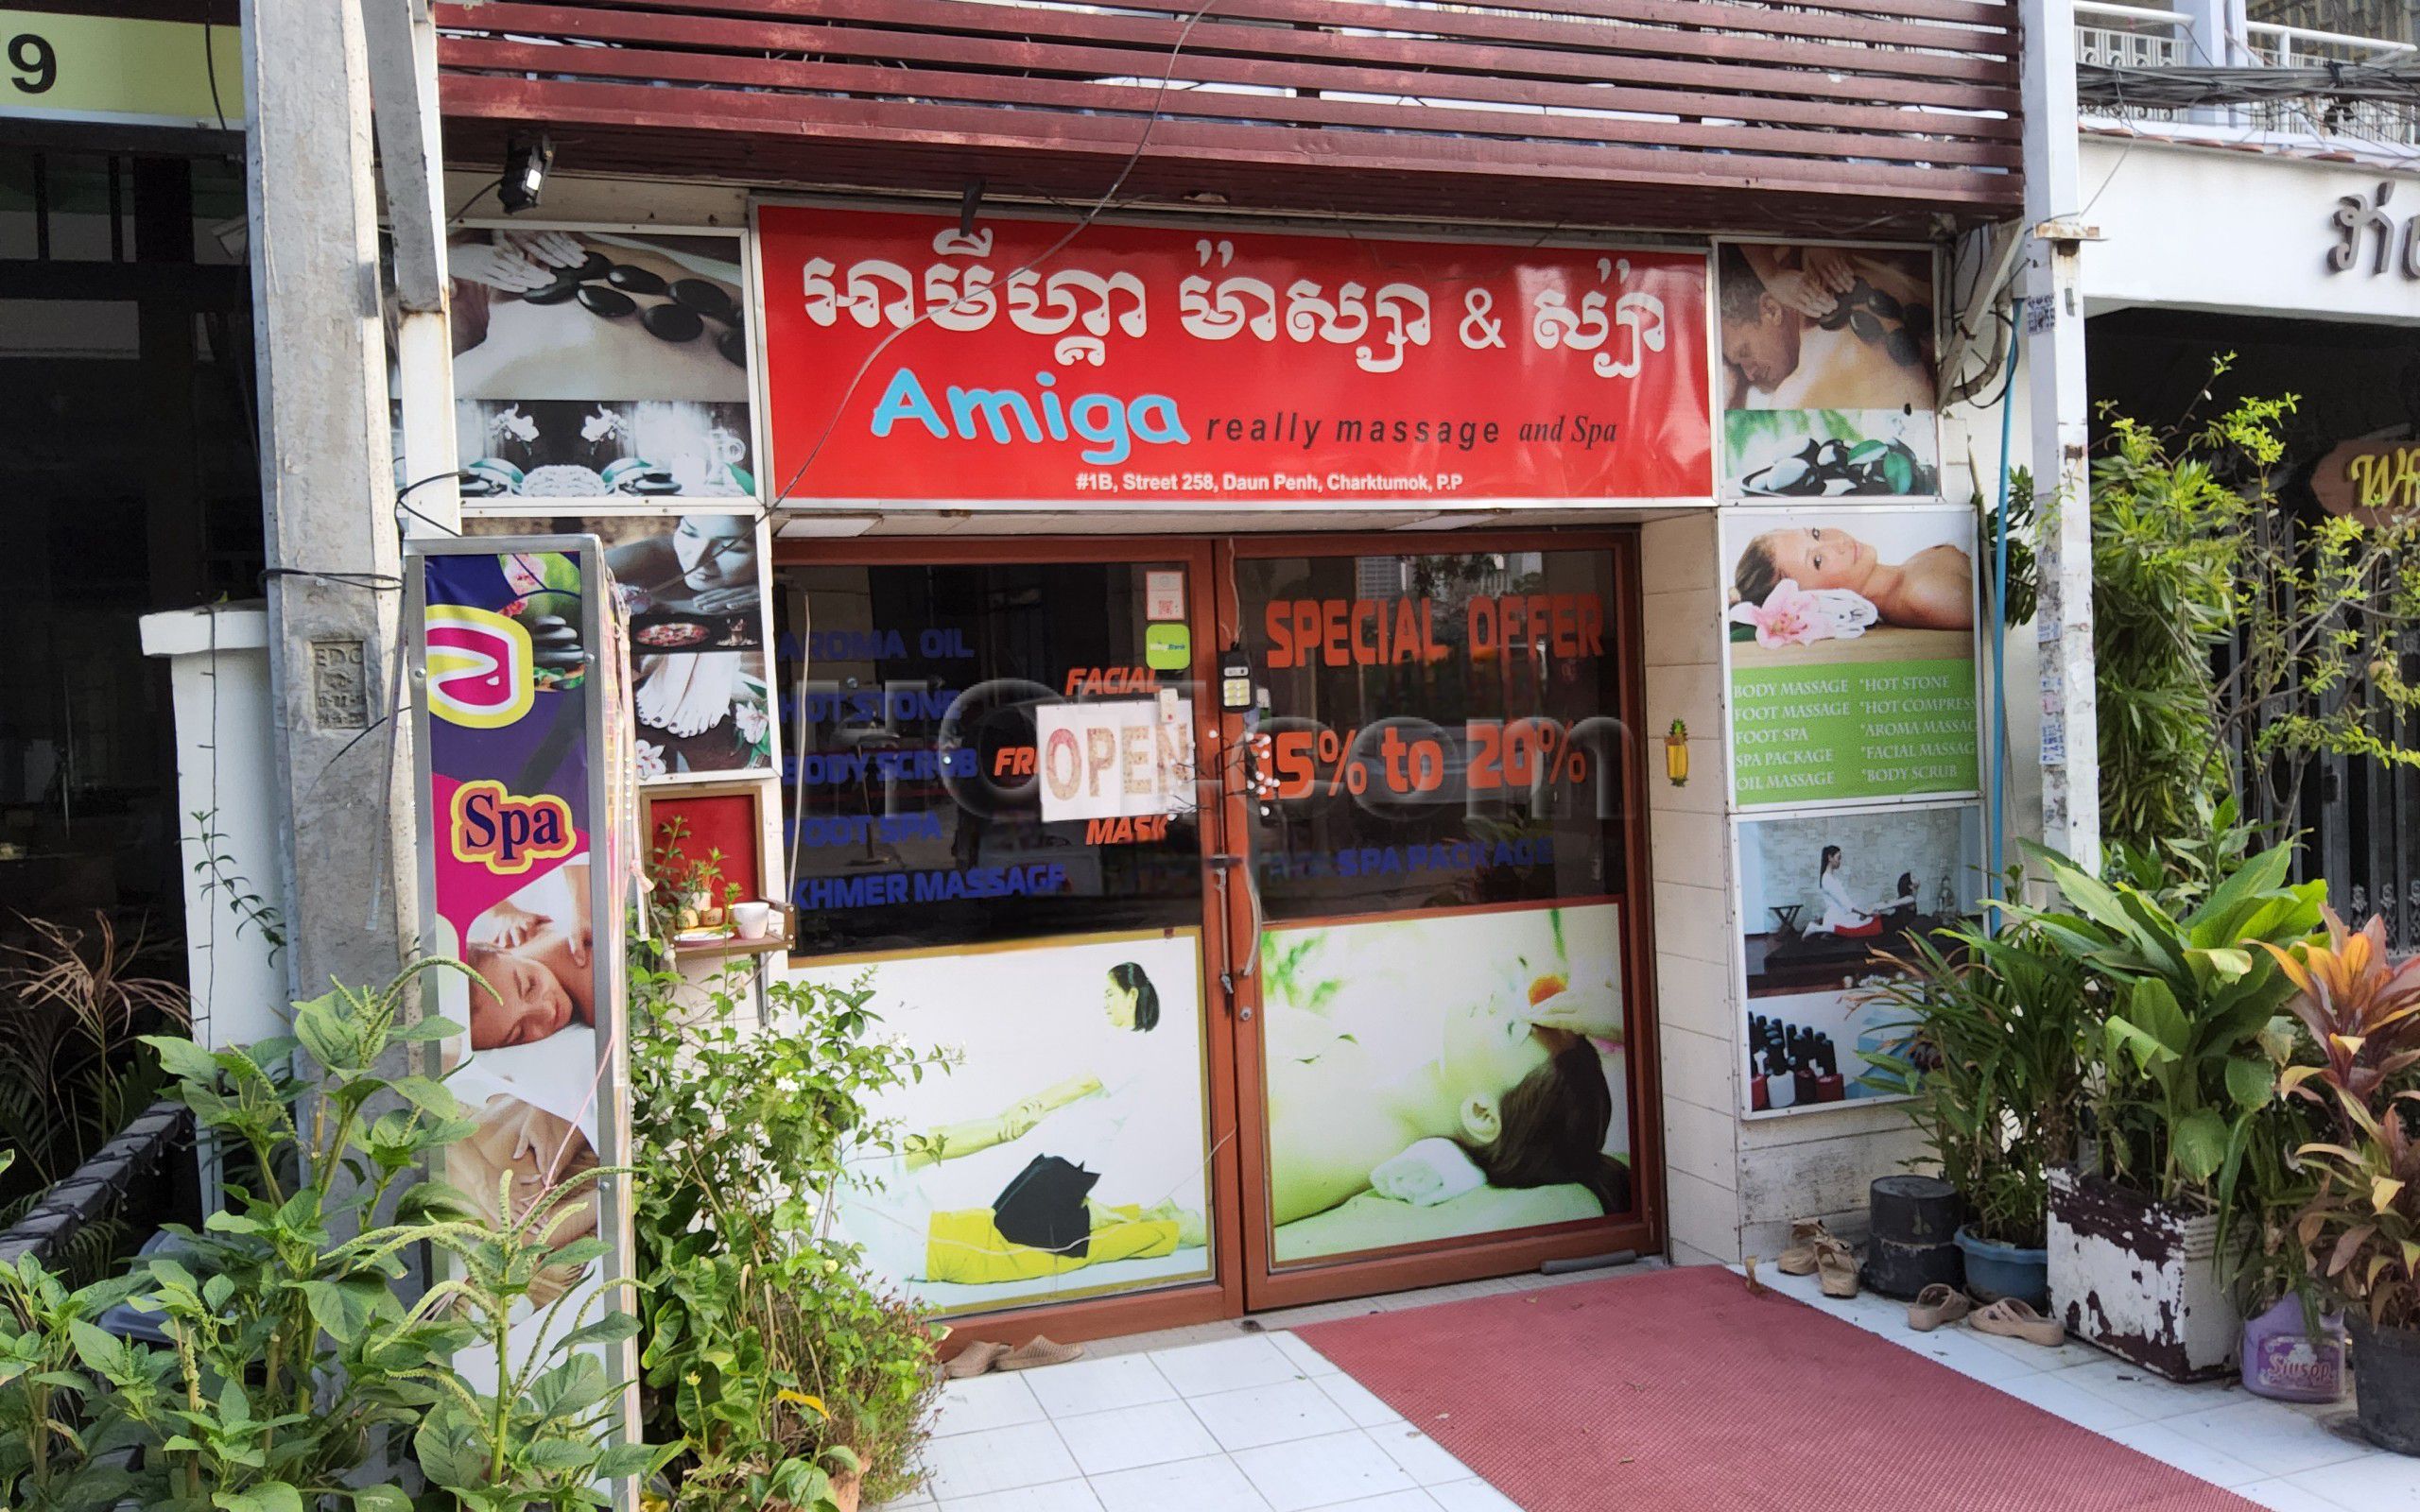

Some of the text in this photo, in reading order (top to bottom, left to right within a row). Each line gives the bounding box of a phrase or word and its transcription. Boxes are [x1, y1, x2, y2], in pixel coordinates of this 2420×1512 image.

[1459, 287, 1507, 351] &
[870, 367, 1617, 466] Amiga really massage and Spa
[1075, 472, 1463, 493] #1B, Street 258, Daun Penh, Charktumok, P.P
[777, 627, 975, 662] AROMA OIL
[1266, 595, 1452, 669] SPECIAL
[1467, 593, 1603, 666] OFFER
[1065, 666, 1163, 696] FACIAL
[1734, 679, 1848, 698] BODY MASSAGE
[1902, 675, 1949, 691] STONE
[780, 691, 843, 724] HOT
[1734, 701, 1851, 722] FOOT MASSAGE
[1736, 726, 1809, 745] FOOT SPA
[782, 747, 979, 786] BODY SCRUB
[994, 747, 1039, 776] FR
[1046, 722, 1190, 801] OPEN
[1250, 719, 1587, 800] 15% to 20%
[1736, 748, 1833, 768] SPA PACKAGE
[1911, 764, 1958, 781] SCRUB
[1737, 770, 1835, 792] OIL MASSAGE
[465, 793, 562, 861] Spa
[877, 809, 943, 844] SPA
[1085, 815, 1169, 845] MASK
[1338, 848, 1403, 877] SPA
[1408, 835, 1554, 872] PACKAGE
[793, 862, 1067, 911] KHMER MASSAGE
